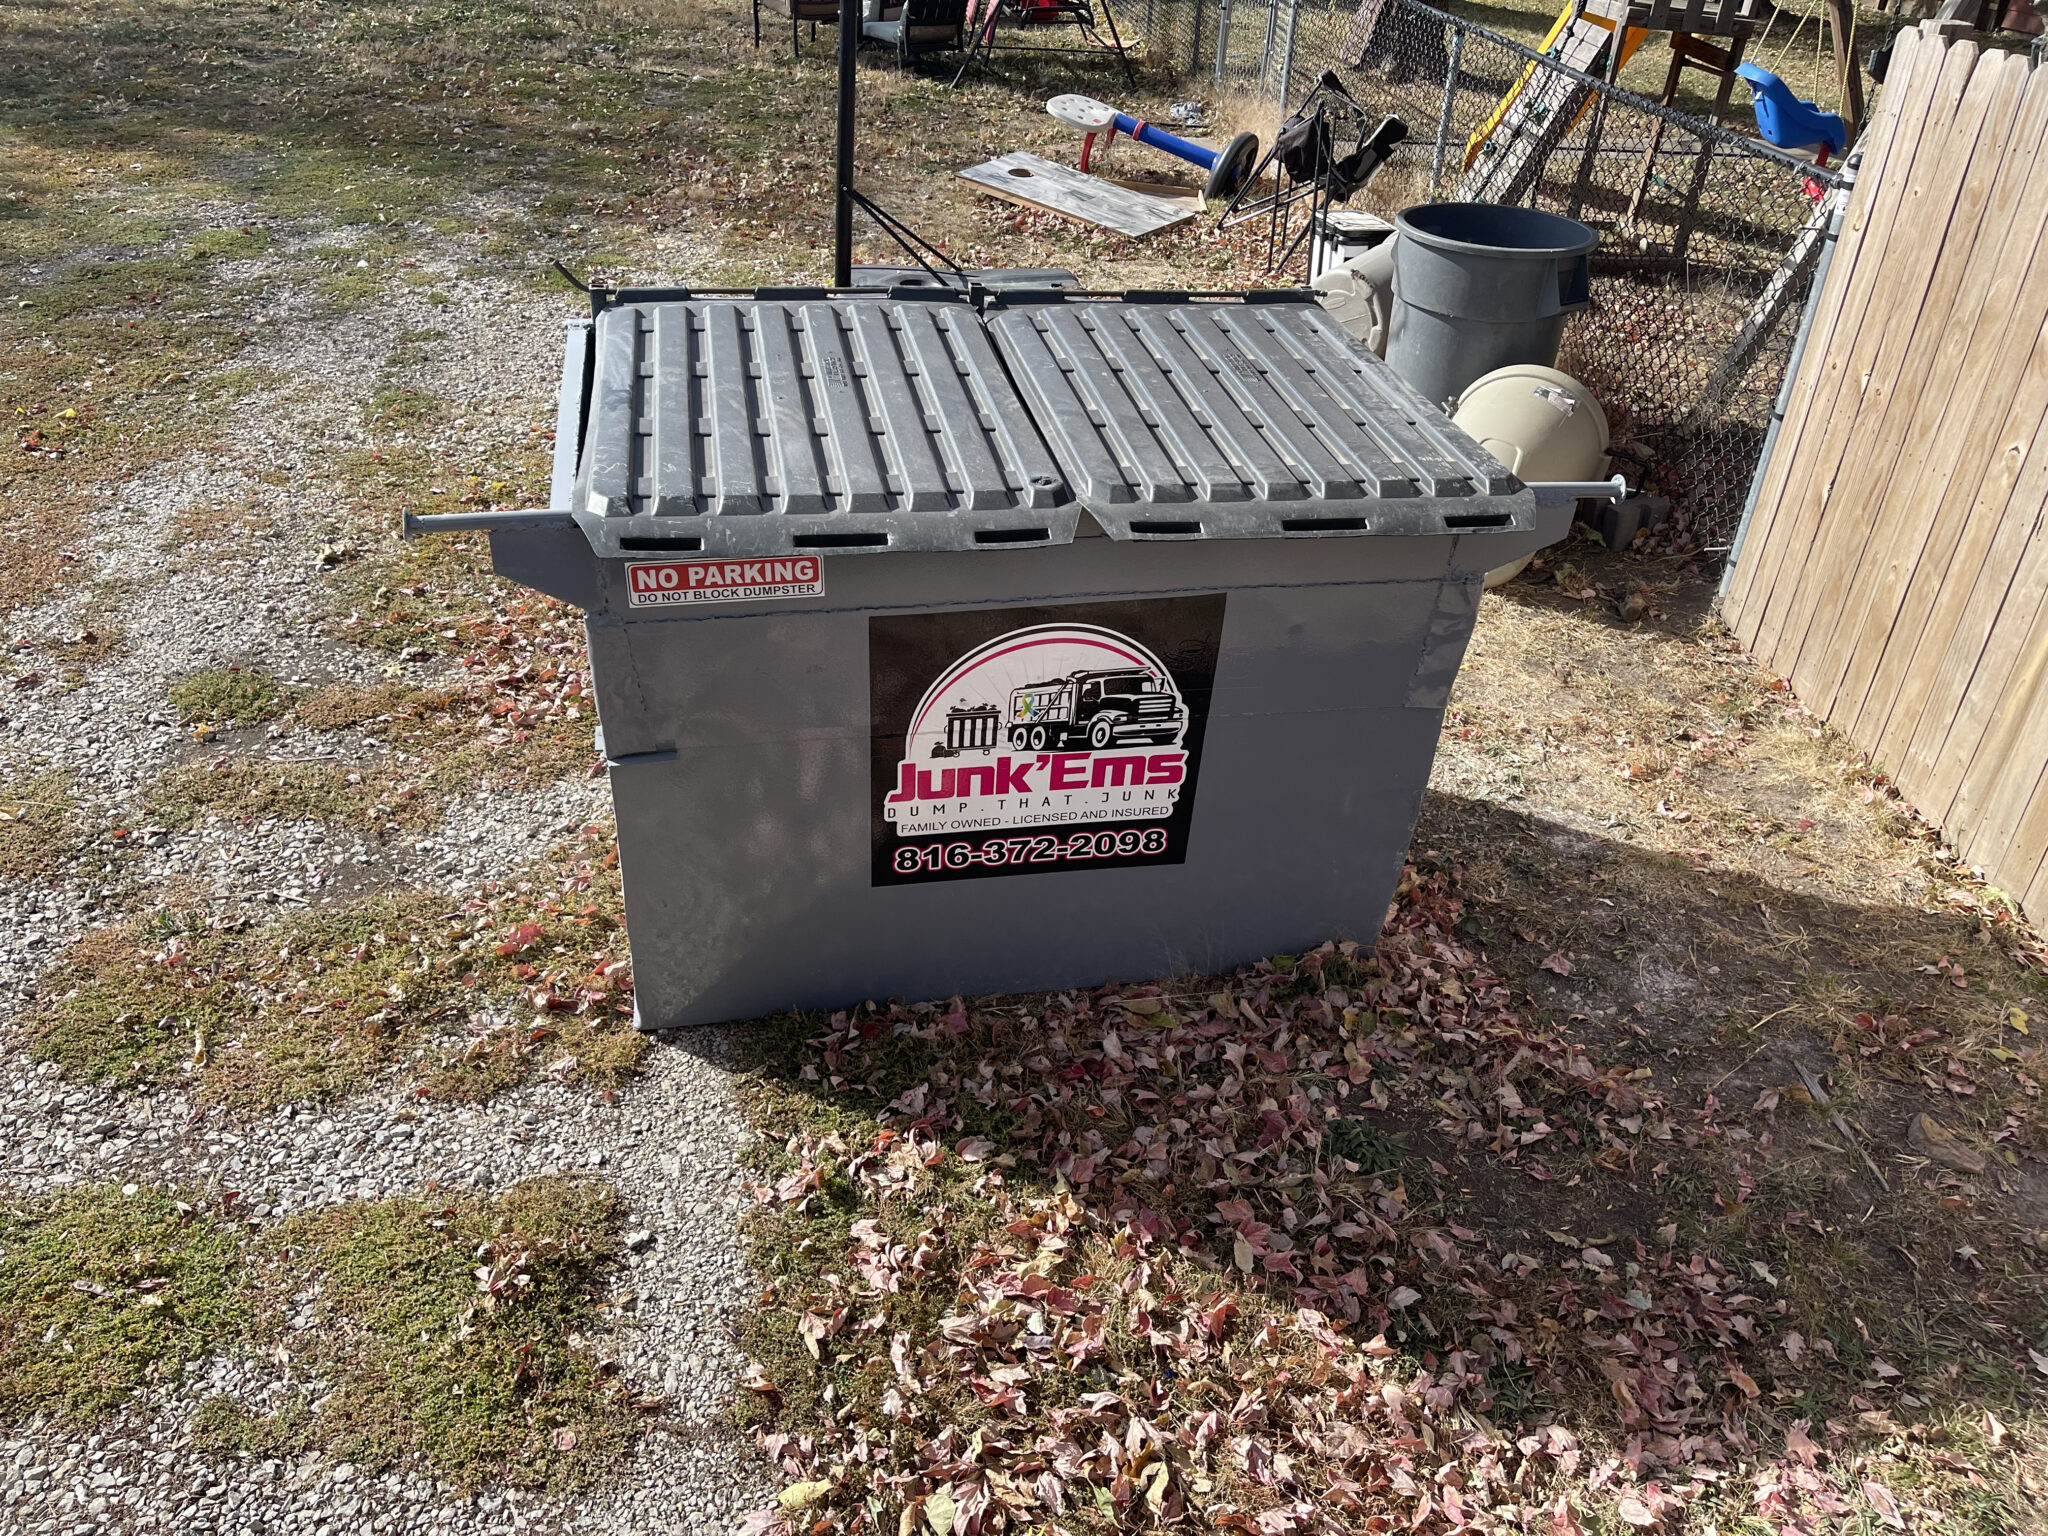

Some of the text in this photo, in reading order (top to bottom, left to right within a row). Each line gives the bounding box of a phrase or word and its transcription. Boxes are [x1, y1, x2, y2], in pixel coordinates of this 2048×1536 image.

[636, 561, 814, 590] NO PARKING
[638, 584, 816, 604] DO NOT BLOCK DUMPSTER
[888, 752, 1188, 803] Junk'Ems
[901, 821, 948, 834] FAMILY
[951, 817, 1001, 830] OWNED
[1013, 811, 1078, 825] LICENSED
[1080, 809, 1108, 820] AND
[1111, 806, 1169, 818] INSURED
[894, 829, 1167, 872] 816-372-2098
